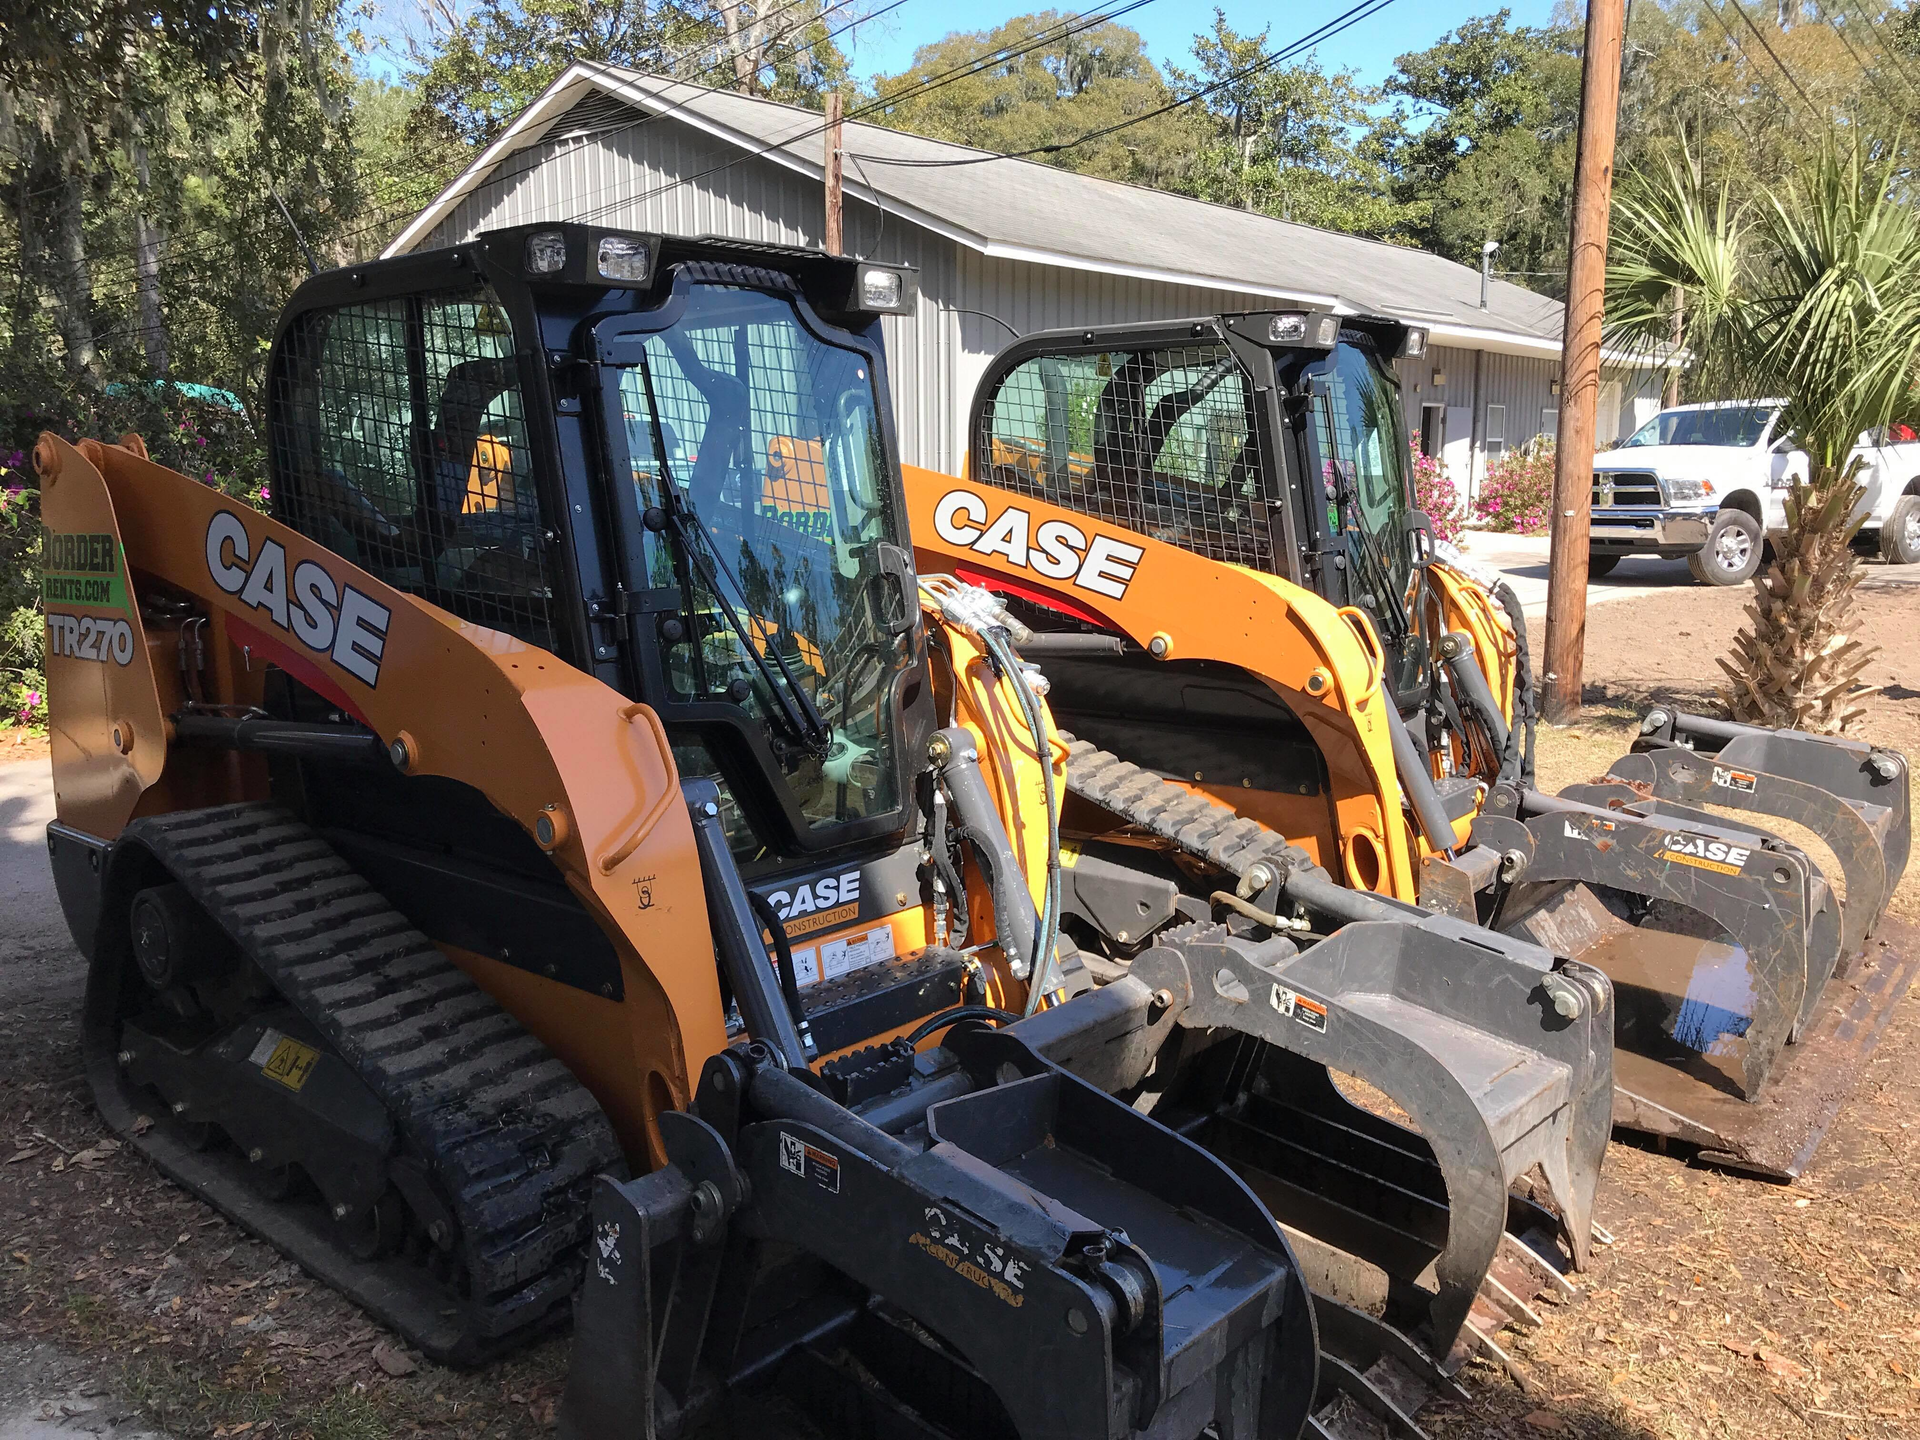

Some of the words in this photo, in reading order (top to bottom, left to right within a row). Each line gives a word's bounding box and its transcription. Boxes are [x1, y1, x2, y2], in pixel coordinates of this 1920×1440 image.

[41, 525, 115, 573] BORDER
[933, 488, 1147, 602] CASE
[45, 577, 111, 603] RENTS.COM
[205, 509, 392, 690] CASE
[47, 611, 134, 667] TR270
[1663, 834, 1751, 868] CASE
[1668, 852, 1738, 875] CONSTRUCTION
[767, 870, 860, 920] CASE
[785, 906, 857, 935] ONSTRUCTION
